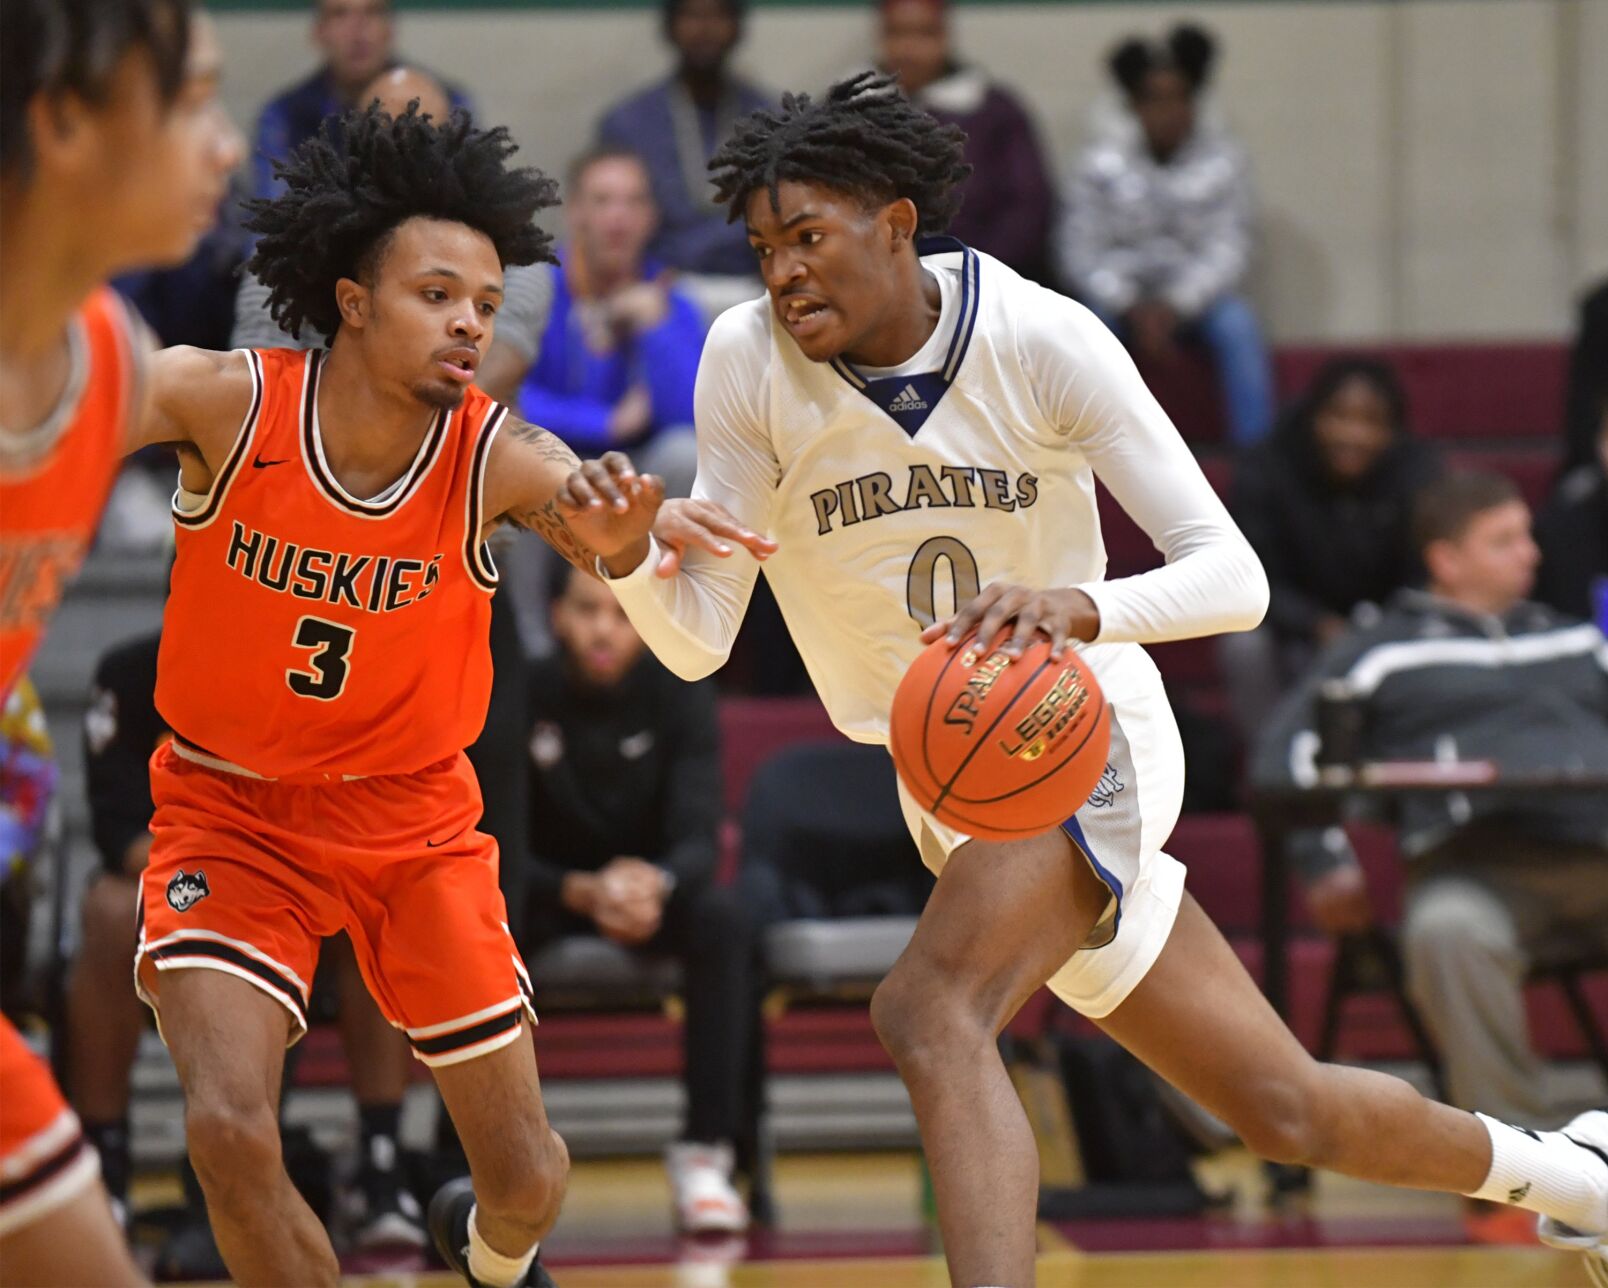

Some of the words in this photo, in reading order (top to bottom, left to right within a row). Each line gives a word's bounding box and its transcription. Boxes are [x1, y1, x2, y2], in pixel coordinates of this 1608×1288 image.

[889, 400, 928, 412] adidas
[810, 464, 1038, 536] PIRATES
[906, 535, 981, 632] 0
[285, 614, 357, 702] 3
[943, 646, 1012, 736] SPALD
